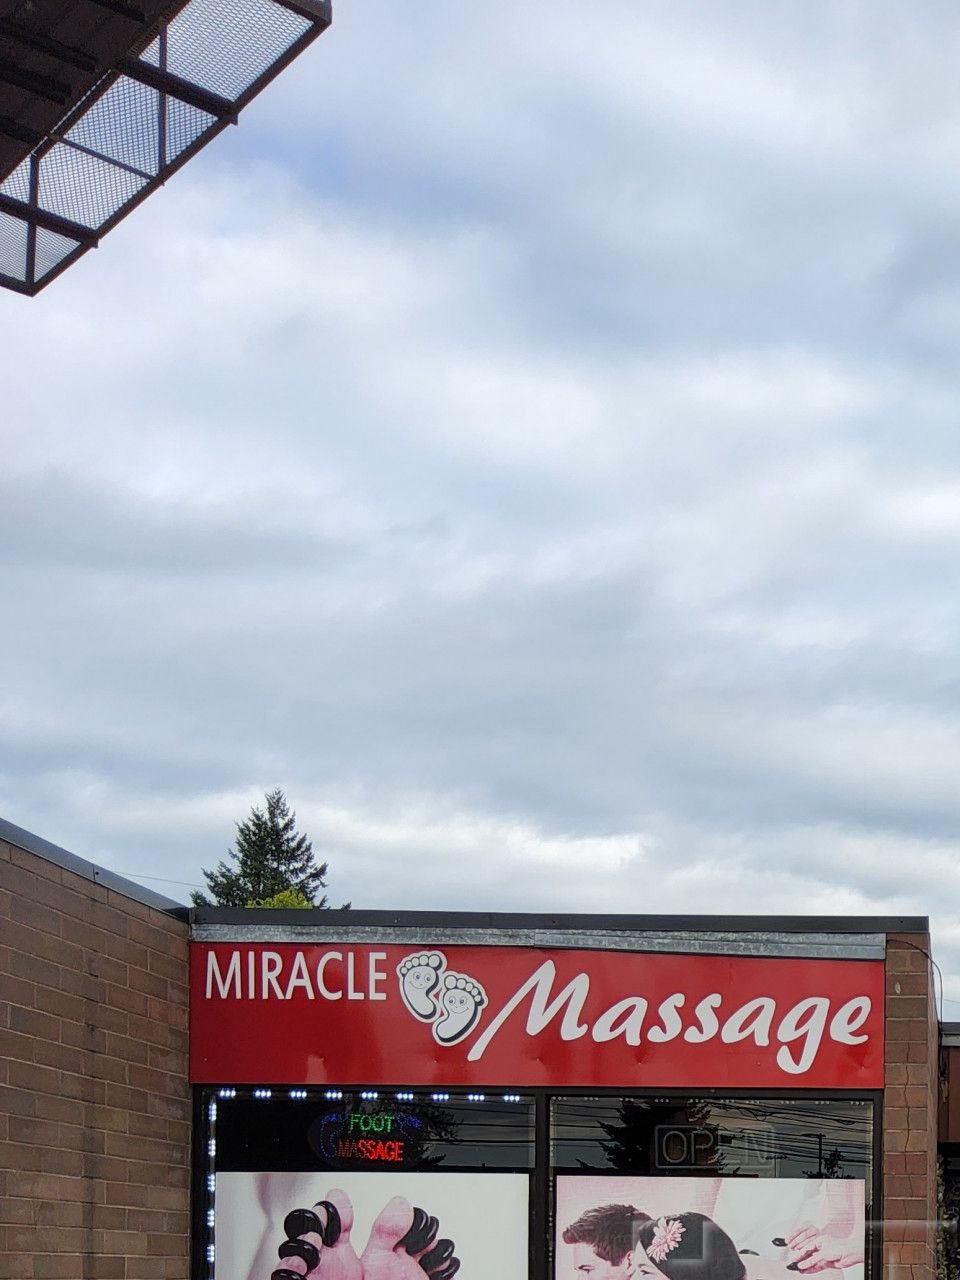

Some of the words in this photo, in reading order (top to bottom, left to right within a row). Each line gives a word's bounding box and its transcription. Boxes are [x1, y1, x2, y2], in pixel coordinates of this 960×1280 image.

[205, 950, 387, 1001] MIRACLE
[468, 960, 870, 1074] Massage
[348, 1114, 395, 1133] FOOT
[337, 1139, 404, 1161] MASSAGE
[662, 1130, 769, 1165] OPEN
